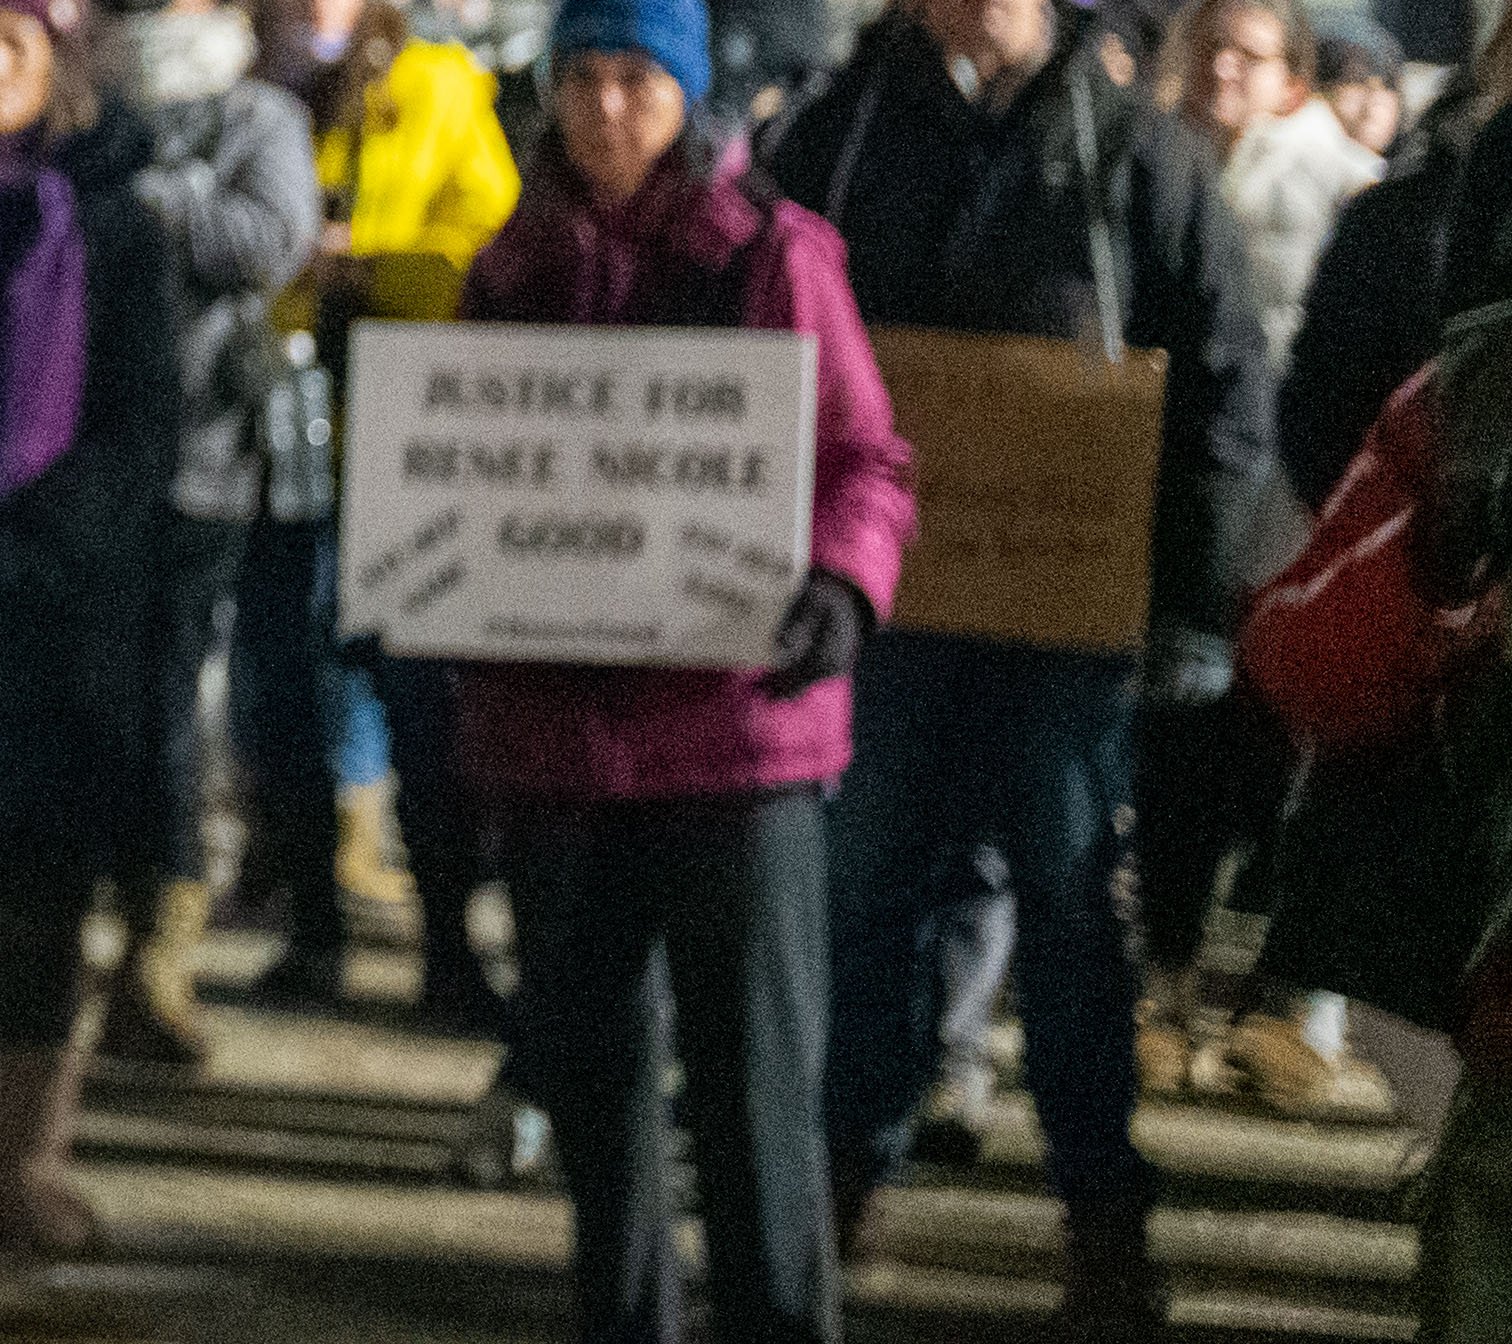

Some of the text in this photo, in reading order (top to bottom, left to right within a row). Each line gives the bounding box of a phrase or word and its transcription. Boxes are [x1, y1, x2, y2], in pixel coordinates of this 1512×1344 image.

[421, 365, 748, 420] JUSTICE FOR
[401, 438, 774, 492] RENEE NICOLE
[495, 512, 648, 562] GOOD
